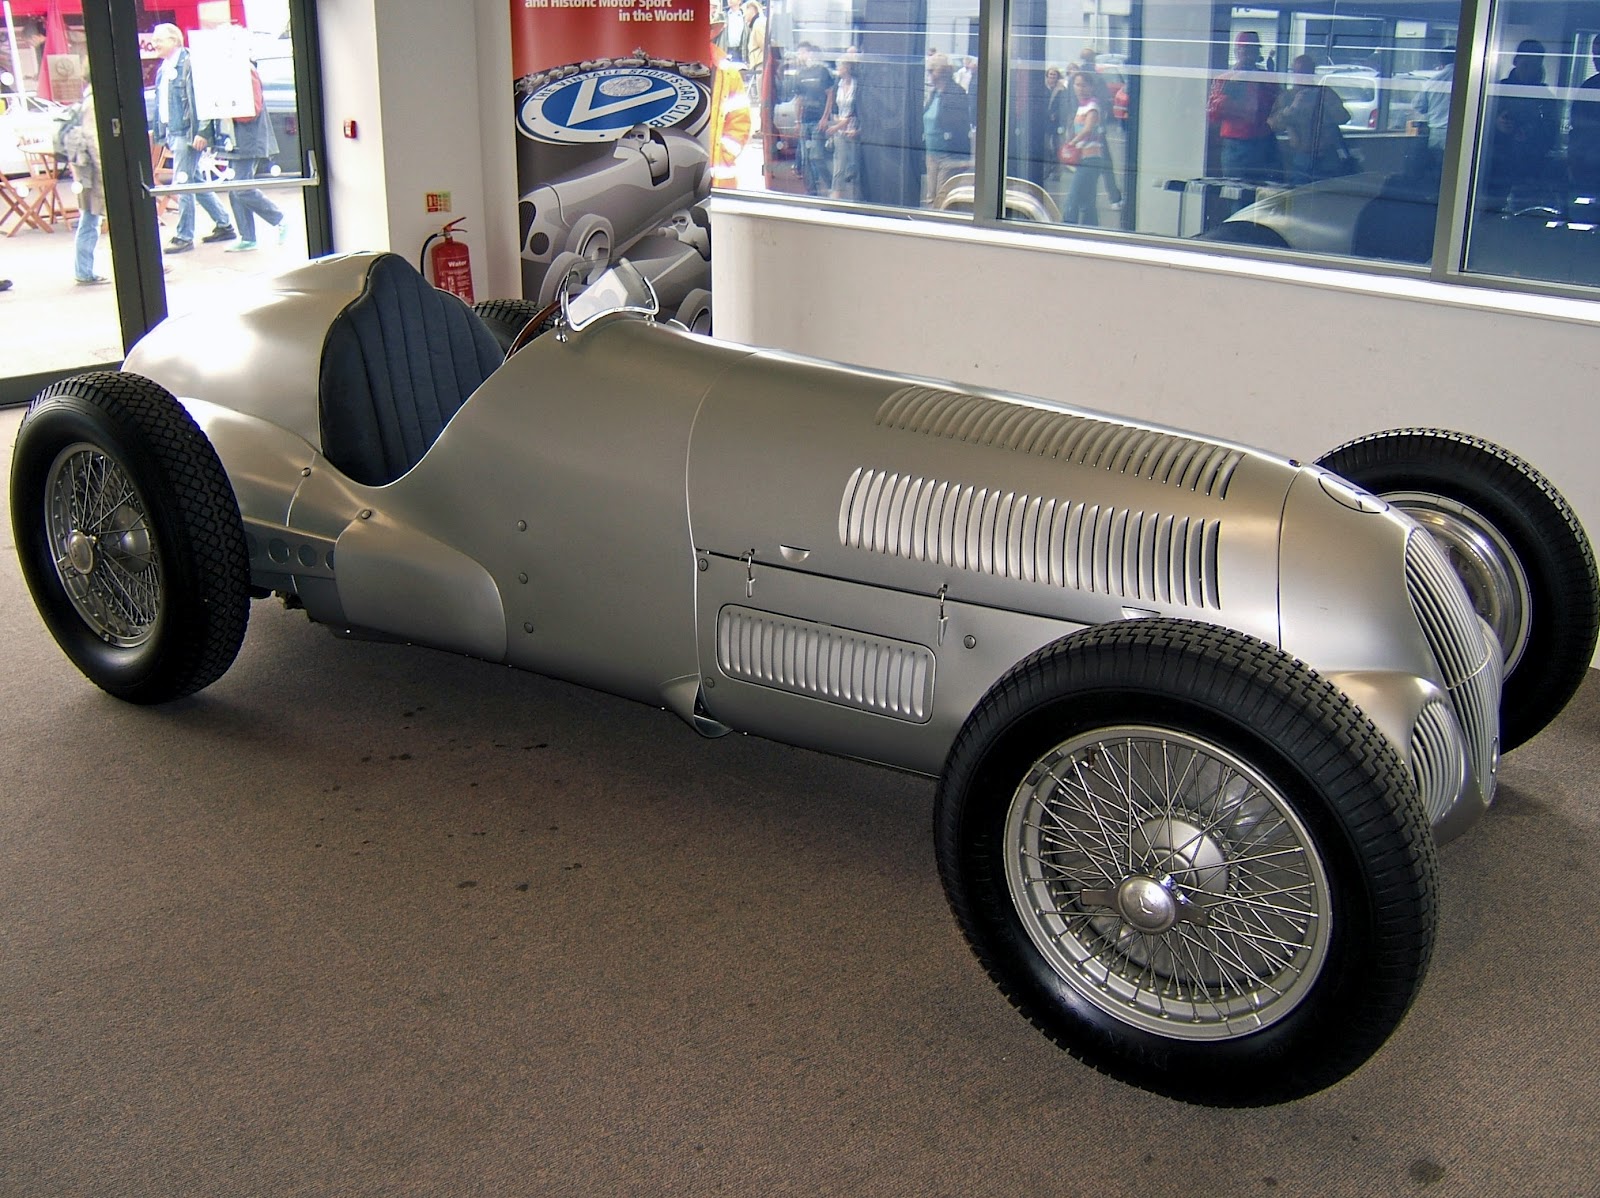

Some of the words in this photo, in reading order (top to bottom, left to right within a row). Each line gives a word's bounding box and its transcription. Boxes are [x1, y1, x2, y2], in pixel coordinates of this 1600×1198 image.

[525, 0, 549, 8] and
[551, 0, 597, 8] Historic
[599, 0, 636, 8] Motor
[639, 0, 672, 10] Sport
[619, 9, 631, 21] in
[632, 9, 653, 21] the
[654, 9, 694, 21] World!
[531, 87, 556, 101] THE
[649, 104, 692, 127] CLUB
